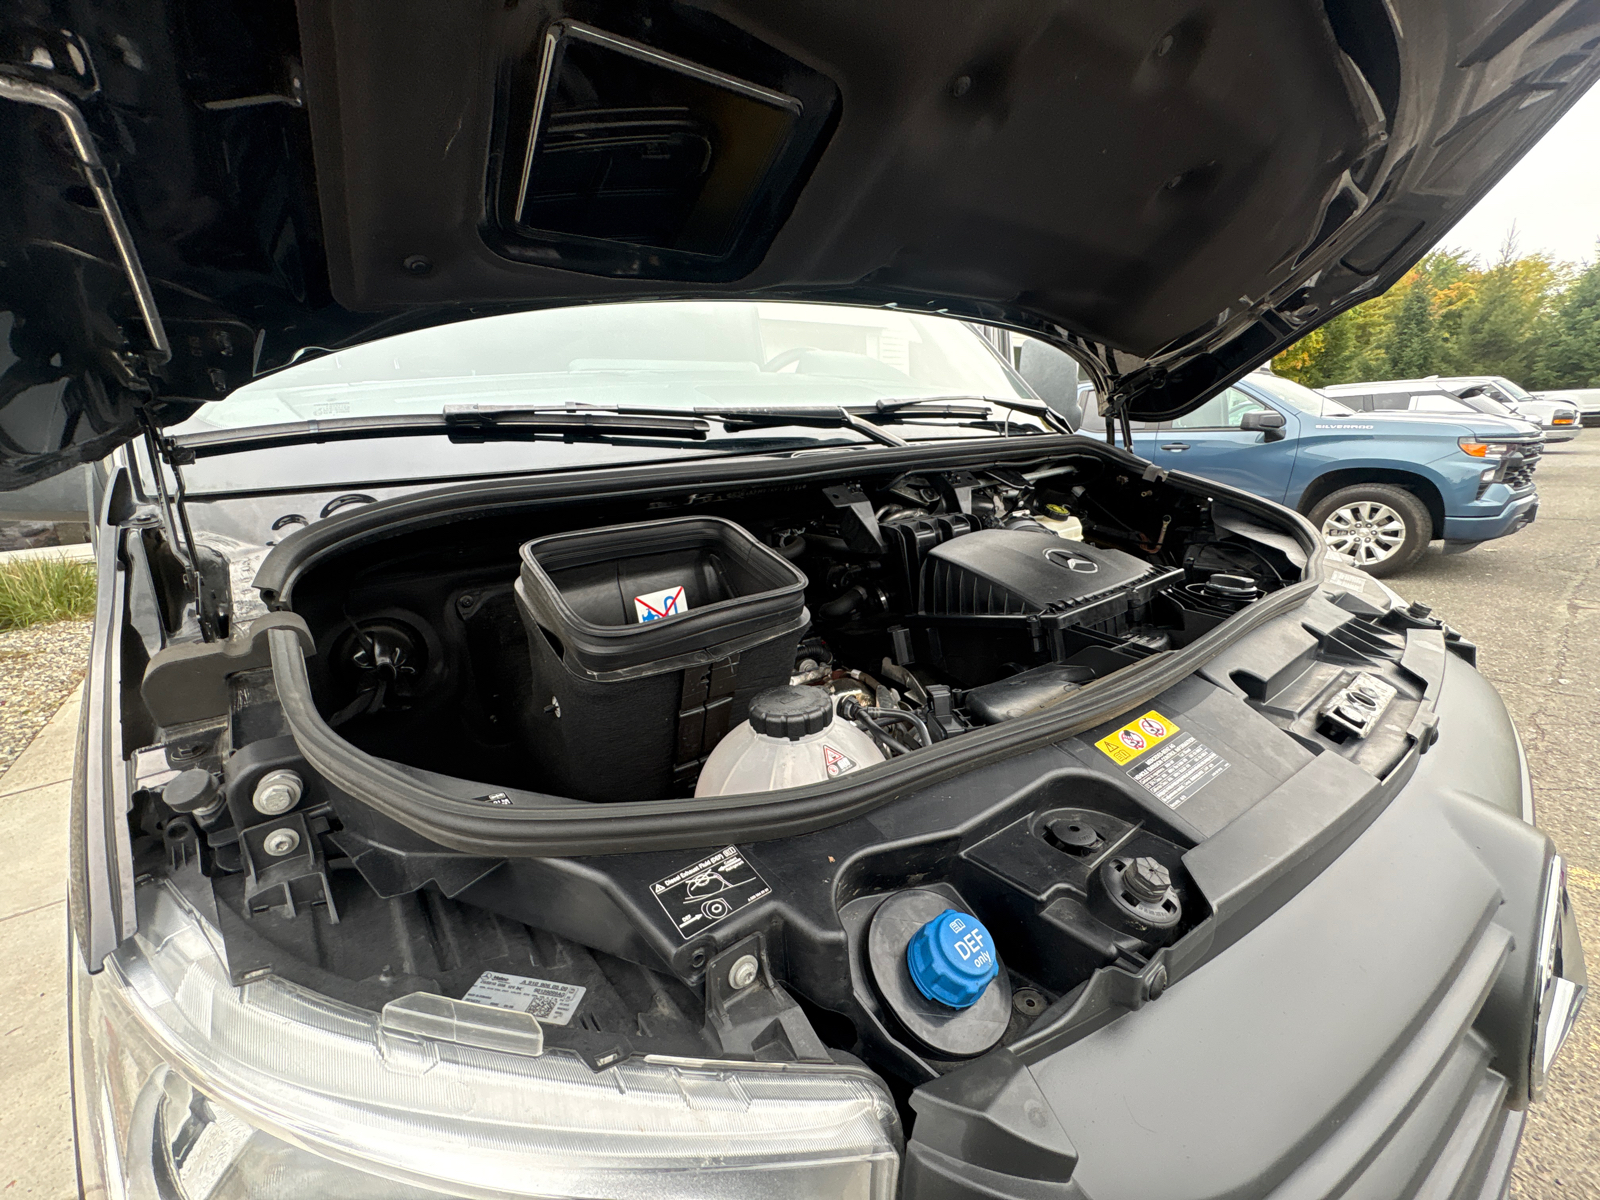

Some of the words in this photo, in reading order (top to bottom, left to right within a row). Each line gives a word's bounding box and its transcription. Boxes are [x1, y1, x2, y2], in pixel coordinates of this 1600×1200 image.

[664, 875, 680, 886] Diesel
[680, 866, 699, 878] Exhaust
[698, 860, 710, 869] Fluid
[682, 914, 692, 922] DEF
[954, 928, 984, 960] DEF
[974, 950, 992, 968] only
